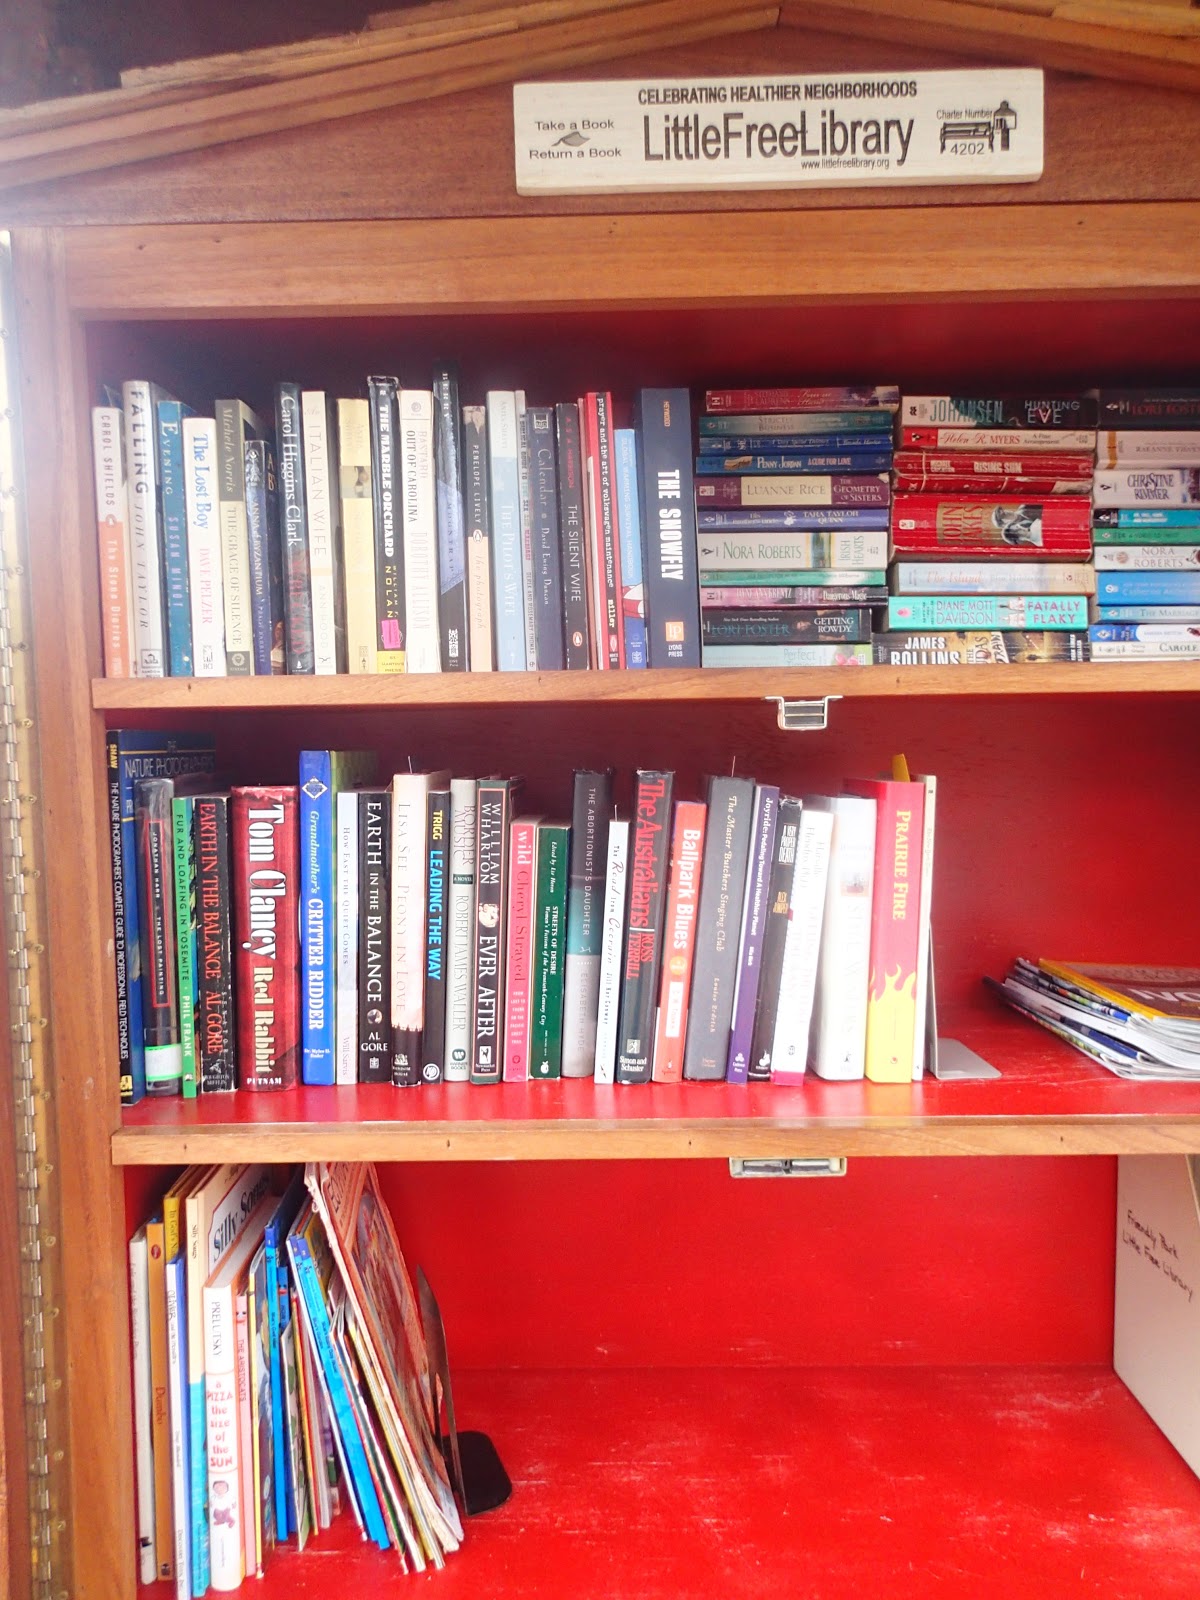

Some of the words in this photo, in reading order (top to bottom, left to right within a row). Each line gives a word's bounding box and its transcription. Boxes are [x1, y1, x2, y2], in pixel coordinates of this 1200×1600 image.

[638, 87, 727, 105] CELEBRATING
[731, 84, 801, 101] HEALTHIER
[804, 81, 917, 99] NEIGHBORHOODS
[535, 120, 566, 132] Take
[582, 119, 614, 130] Book
[937, 109, 962, 120] Charter
[965, 109, 993, 119] Number
[529, 148, 572, 160] Return
[577, 150, 584, 158] a
[590, 147, 621, 158] Book
[643, 110, 914, 165] LittleFreeLibrary
[951, 142, 985, 156] 4202
[801, 158, 889, 170] www.littlefreelibrary.org
[281, 396, 296, 437] Carol
[379, 405, 390, 432] THE
[595, 398, 607, 425] prayer
[930, 400, 1003, 423] JOHANSEN
[1024, 400, 1080, 410] HUNTING
[1027, 409, 1061, 424] EVE
[101, 416, 111, 450] CAROL
[130, 391, 148, 494] FALLING
[222, 407, 234, 452] Michele
[406, 430, 416, 452] OUT
[599, 428, 608, 442] and
[192, 434, 208, 461] The
[380, 435, 392, 489] MARBLE
[406, 454, 417, 468] OF
[600, 445, 608, 459] the
[757, 456, 777, 469] PENNY
[779, 456, 802, 469] JORDAN
[104, 458, 115, 506] SHIELDS
[195, 467, 210, 498] Lost
[224, 456, 235, 493] Norris
[280, 443, 297, 500] Higgins
[472, 445, 480, 486] PENELOPE
[537, 449, 552, 506] Calendar
[601, 461, 609, 475] art
[602, 477, 610, 486] of
[1127, 473, 1174, 488] CHRISTINE
[407, 471, 418, 523] CAROLINA
[657, 470, 680, 499] THE
[747, 484, 794, 496] LUANNE
[800, 485, 826, 495] RICE
[833, 486, 880, 494] GEOMETRY
[134, 504, 144, 550] JOHN
[195, 502, 212, 529] Boy
[227, 507, 237, 533] THE
[286, 505, 302, 547] Clark
[382, 491, 394, 557] ORCHARD
[568, 504, 578, 528] THE
[602, 489, 613, 535] volkswagen
[168, 517, 179, 558] SUSAN
[568, 531, 580, 570] SILENT
[658, 508, 683, 580] SNOWFLY
[723, 541, 754, 559] NORA
[758, 544, 802, 559] ROBERTS
[1142, 547, 1175, 555] NORA
[199, 548, 210, 578] DAVE
[228, 535, 239, 575] GRACE
[604, 537, 615, 588] maintenance
[1134, 559, 1183, 567] ROBERTS
[136, 563, 149, 629] TAYLOR
[171, 568, 183, 607] MINOT
[230, 577, 239, 592] OF
[385, 566, 394, 618] NOLAN
[570, 573, 581, 602] WIFE
[200, 580, 213, 624] PELZER
[936, 601, 965, 610] DIANE
[968, 600, 992, 609] MOTT
[936, 612, 993, 624] DAVIDSON
[1028, 601, 1080, 611] FATALLY
[1033, 614, 1075, 624] FLAKY
[230, 595, 242, 645] SILENCE
[814, 617, 854, 625] GETTING
[817, 625, 852, 633] ROWDY
[891, 651, 960, 665] ROLLINS
[905, 637, 946, 650] JAMES
[1160, 643, 1197, 652] CAROLE
[109, 744, 118, 768] SHAW
[111, 782, 119, 794] THE
[588, 788, 596, 805] THE
[641, 779, 664, 817] The
[727, 795, 738, 813] The
[111, 796, 120, 821] NATURE
[432, 810, 443, 841] TRIGG
[760, 798, 773, 833] Joyride:
[199, 803, 218, 852] EARTH
[248, 804, 285, 862] Tom
[367, 802, 382, 865] EARTH
[462, 805, 476, 866] BORDER
[480, 802, 492, 885] WHARTON
[490, 802, 501, 885] WILLIAM
[724, 815, 736, 849] Master
[894, 810, 912, 877] PRAIRIE
[176, 837, 185, 861] AND
[308, 810, 321, 894] Grandmother's
[517, 831, 531, 864] wild
[584, 809, 596, 882] ABORTIONIST'S
[202, 856, 218, 872] IN
[370, 873, 379, 885] IN
[429, 850, 443, 912] LEADING
[630, 820, 662, 928] Australians
[677, 829, 700, 900] Ballpark
[720, 851, 733, 892] Butchers
[114, 881, 123, 916] COMPLETE
[177, 864, 187, 911] LOAFING
[202, 875, 218, 908] THE
[369, 888, 379, 910] THE
[513, 870, 529, 919] Cheryl
[892, 881, 909, 920] FIRE
[116, 918, 124, 938] GUIDE
[155, 917, 163, 933] THE
[179, 915, 187, 925] IN
[242, 870, 286, 961] Clancy
[454, 895, 468, 942] ROBERT
[550, 906, 559, 939] STREETS
[582, 886, 592, 936] DAUGHTER
[673, 903, 692, 949] Blues
[715, 894, 728, 928] Singing
[116, 940, 124, 949] TO
[203, 912, 221, 979] BALANCE
[307, 898, 323, 967] CRITTER
[428, 916, 442, 945] THE
[549, 940, 558, 949] OF
[639, 933, 655, 962] ROSS
[715, 930, 727, 952] Club
[179, 930, 190, 981] YOSEMITE
[366, 915, 382, 1002] BALANCE
[428, 947, 441, 979] WAY
[453, 943, 468, 980] JAMES
[479, 935, 498, 979] EVER
[513, 925, 529, 982] Strayed
[549, 951, 557, 975] DESIRE
[626, 933, 642, 979] TERRILL
[117, 951, 126, 998] PROFESSIONAL
[157, 958, 165, 995] PAINTING
[253, 967, 274, 1004] Red
[119, 1000, 127, 1015] FIELD
[182, 995, 191, 1020] PHIL
[206, 990, 221, 1011] AL
[308, 970, 325, 1030] RIDDER
[452, 983, 468, 1031] WALLER
[477, 985, 497, 1040] AFTER
[119, 1017, 128, 1059] TECHNIQUES
[183, 1023, 193, 1057] FRANK
[207, 1014, 223, 1054] GORE
[254, 1010, 276, 1073] Rabbit
[361, 1043, 389, 1051] GORE
[368, 1032, 382, 1040] AL
[1163, 1261, 1193, 1303] Library
[211, 1301, 222, 1356] PRELUTSKY
[237, 1339, 245, 1352] THE
[238, 1356, 247, 1402] ARISTOCATS
